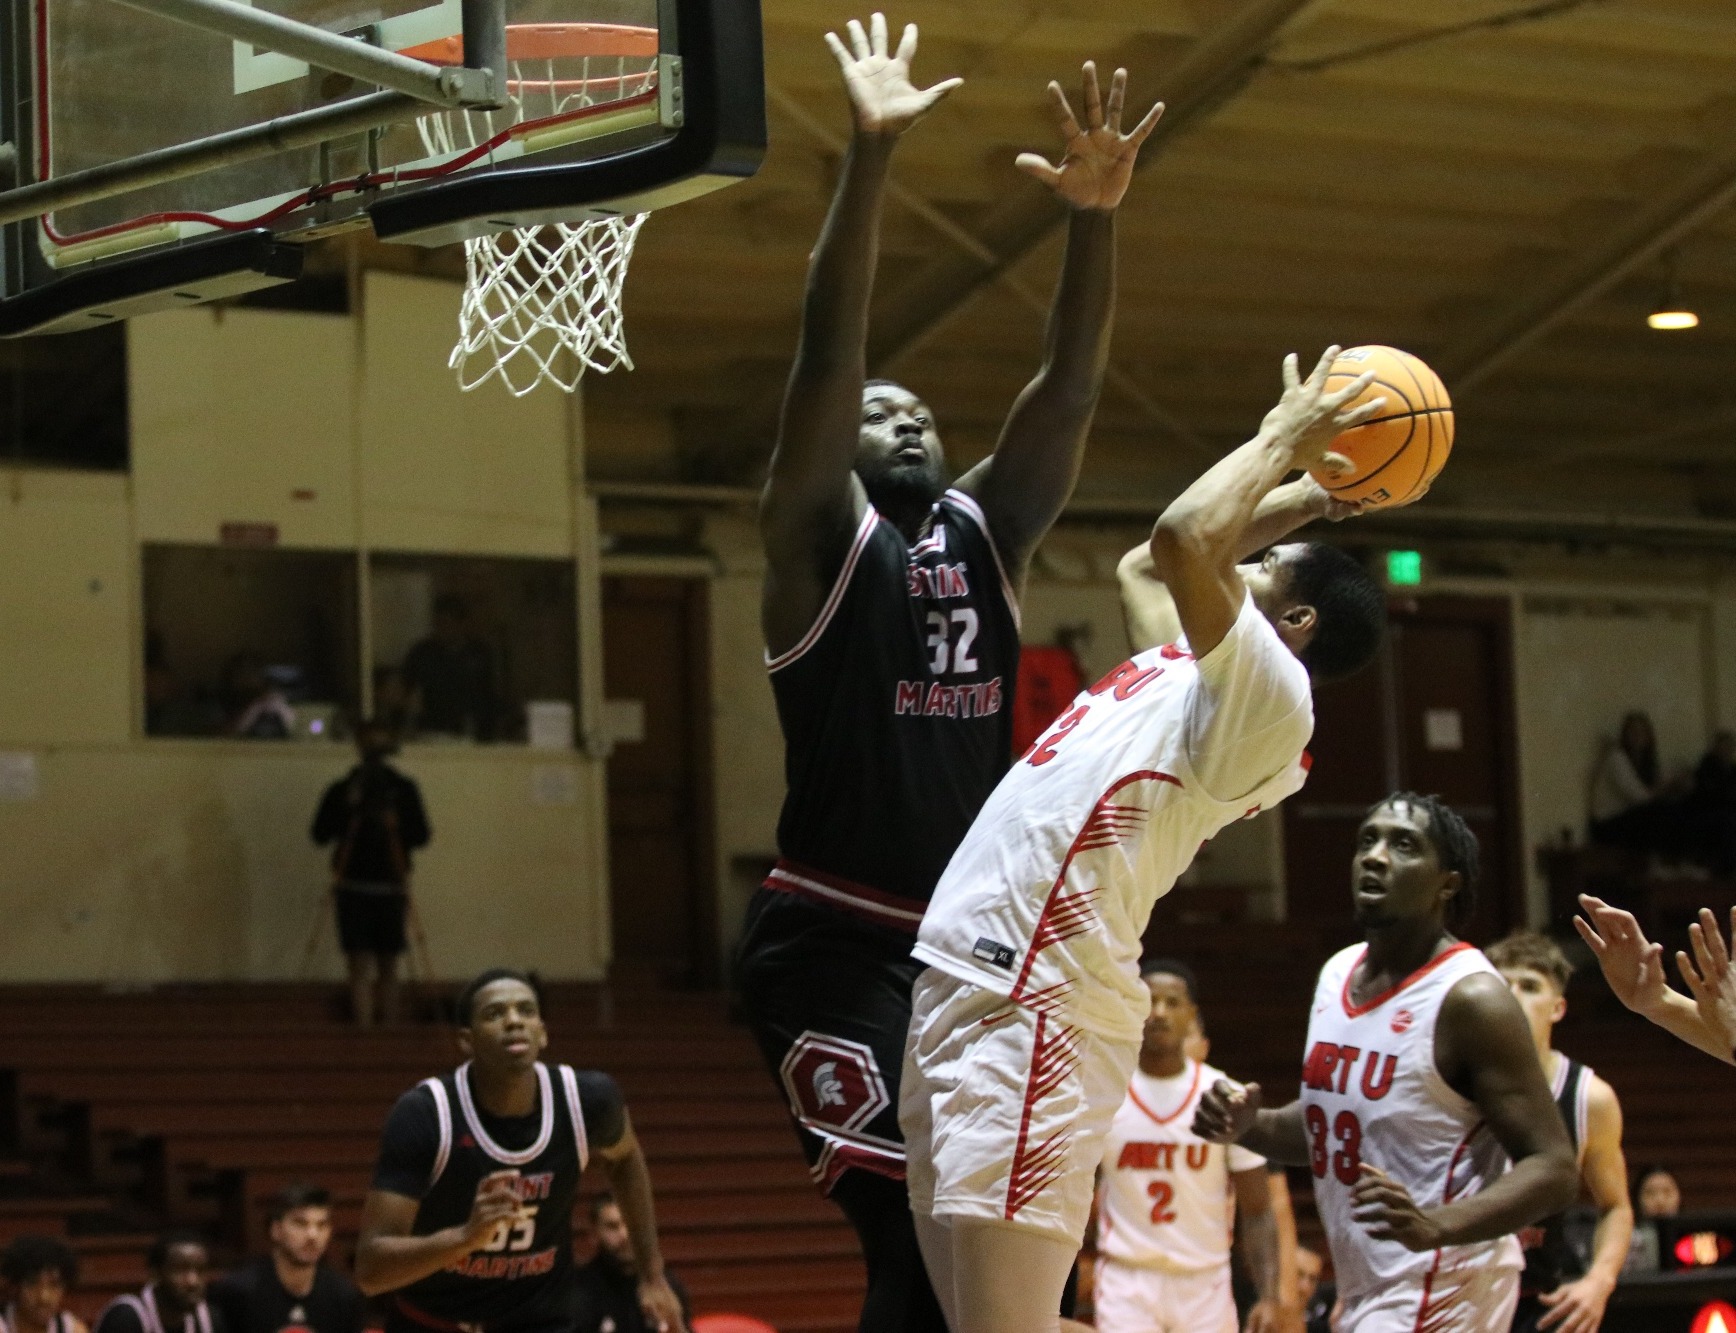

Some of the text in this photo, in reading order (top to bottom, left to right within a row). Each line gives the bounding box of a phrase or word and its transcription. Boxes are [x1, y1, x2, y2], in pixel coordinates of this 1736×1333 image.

[926, 608, 979, 674] 32
[1360, 1051, 1398, 1101] U
[1186, 1143, 1209, 1171] U
[1305, 1104, 1361, 1186] 33
[1147, 1180, 1177, 1225] 2
